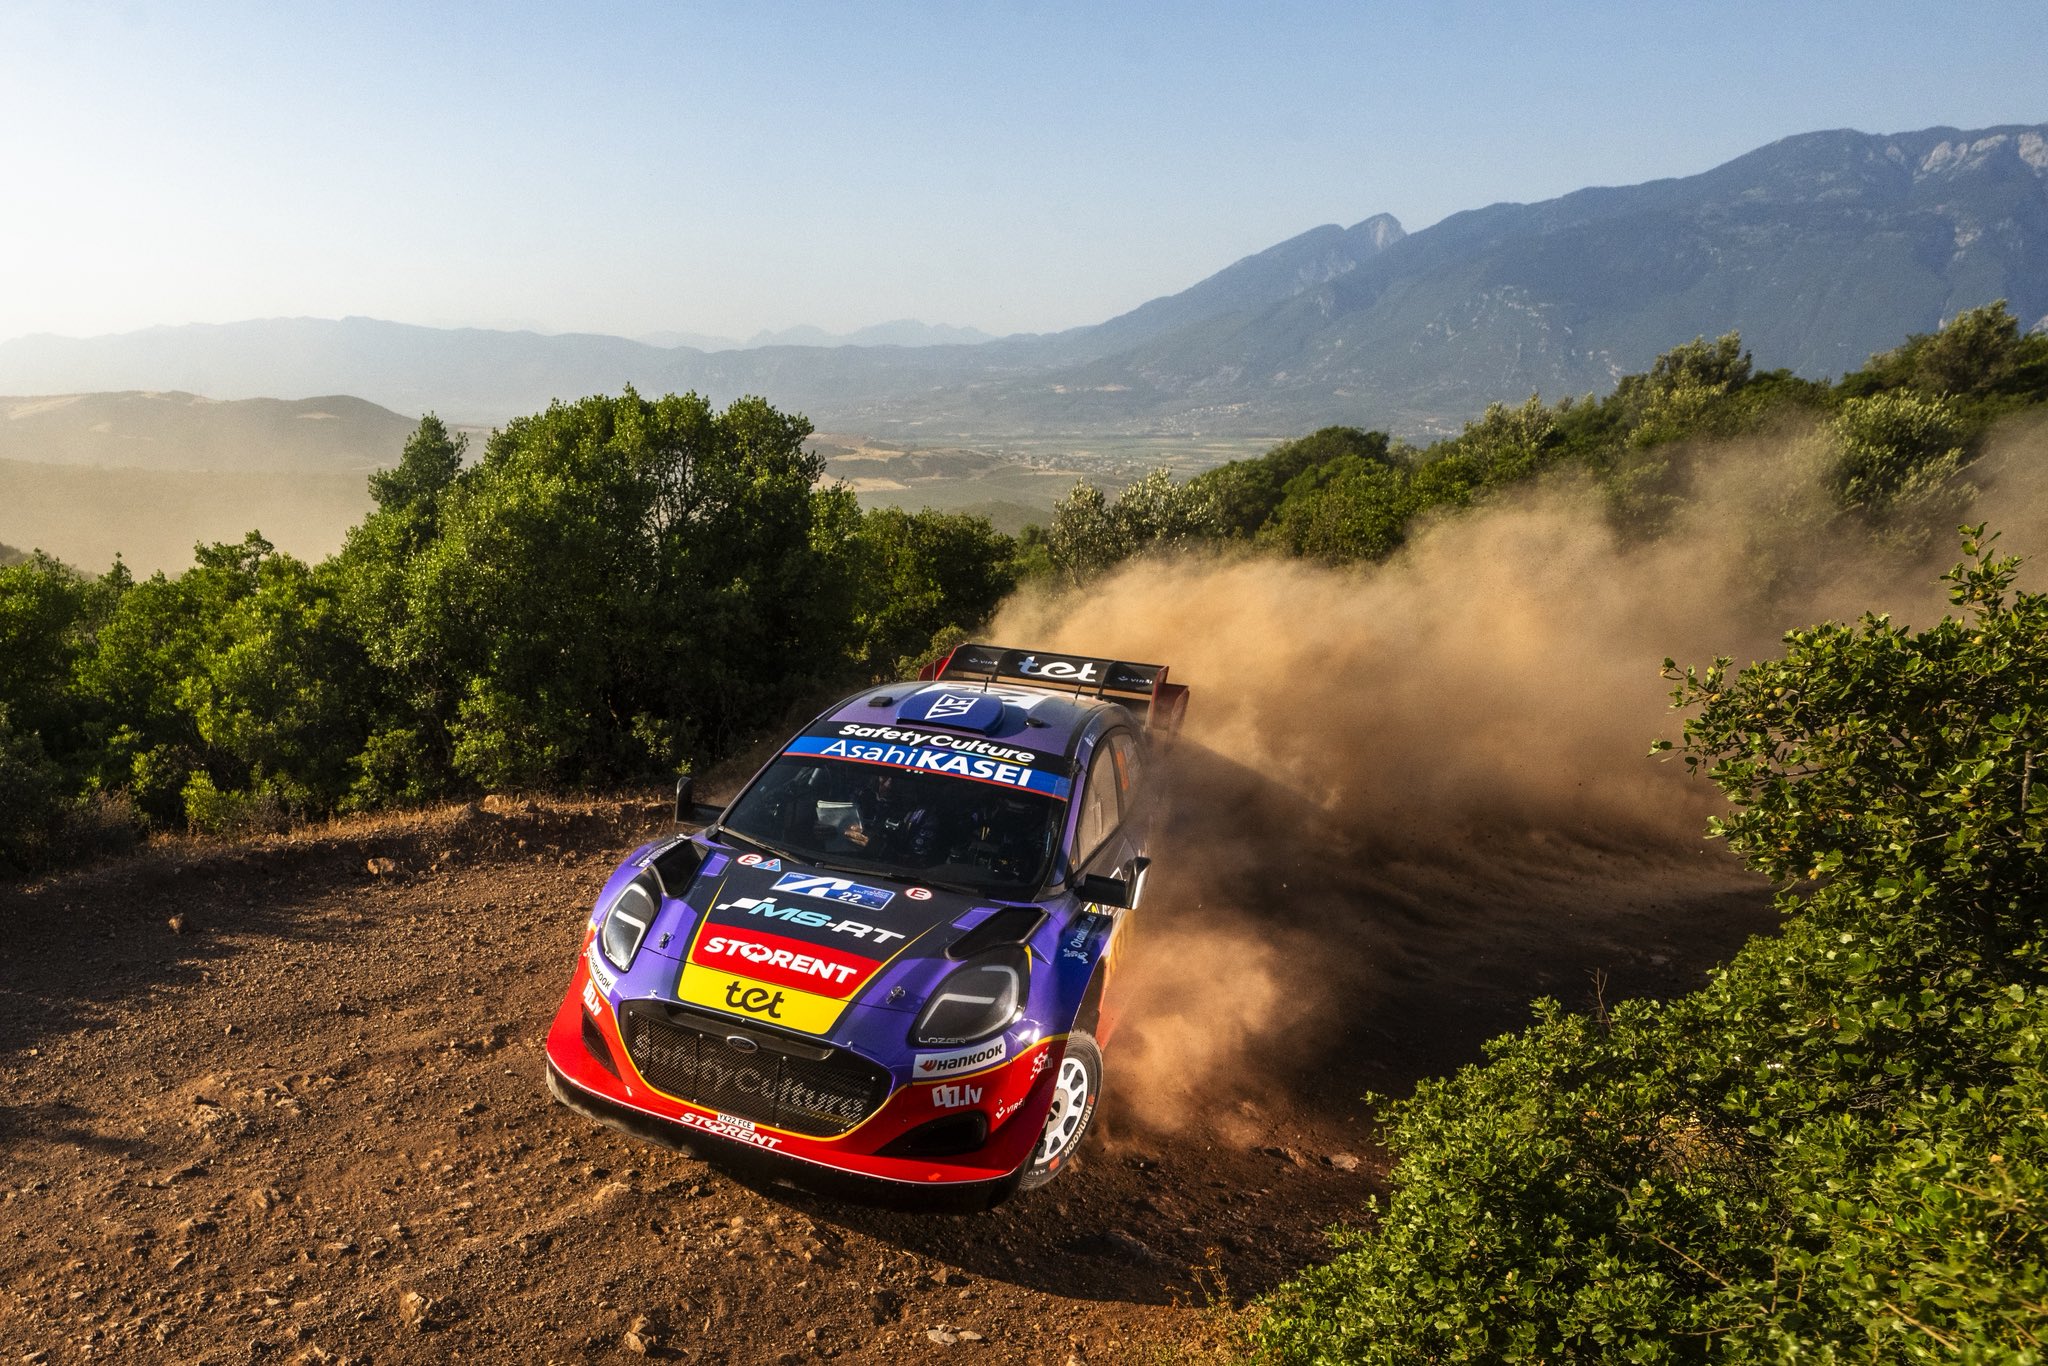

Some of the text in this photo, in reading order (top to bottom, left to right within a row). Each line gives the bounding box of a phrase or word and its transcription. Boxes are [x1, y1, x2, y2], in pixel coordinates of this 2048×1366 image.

[1018, 655, 1098, 682] tet
[839, 723, 1035, 763] SafetyCulture
[743, 855, 756, 865] E
[838, 891, 863, 903] 22
[911, 888, 927, 899] E
[748, 902, 906, 944] MS-RT
[703, 936, 857, 984] STORENT
[725, 981, 785, 1018] tet
[680, 1112, 783, 1149] STORENT
